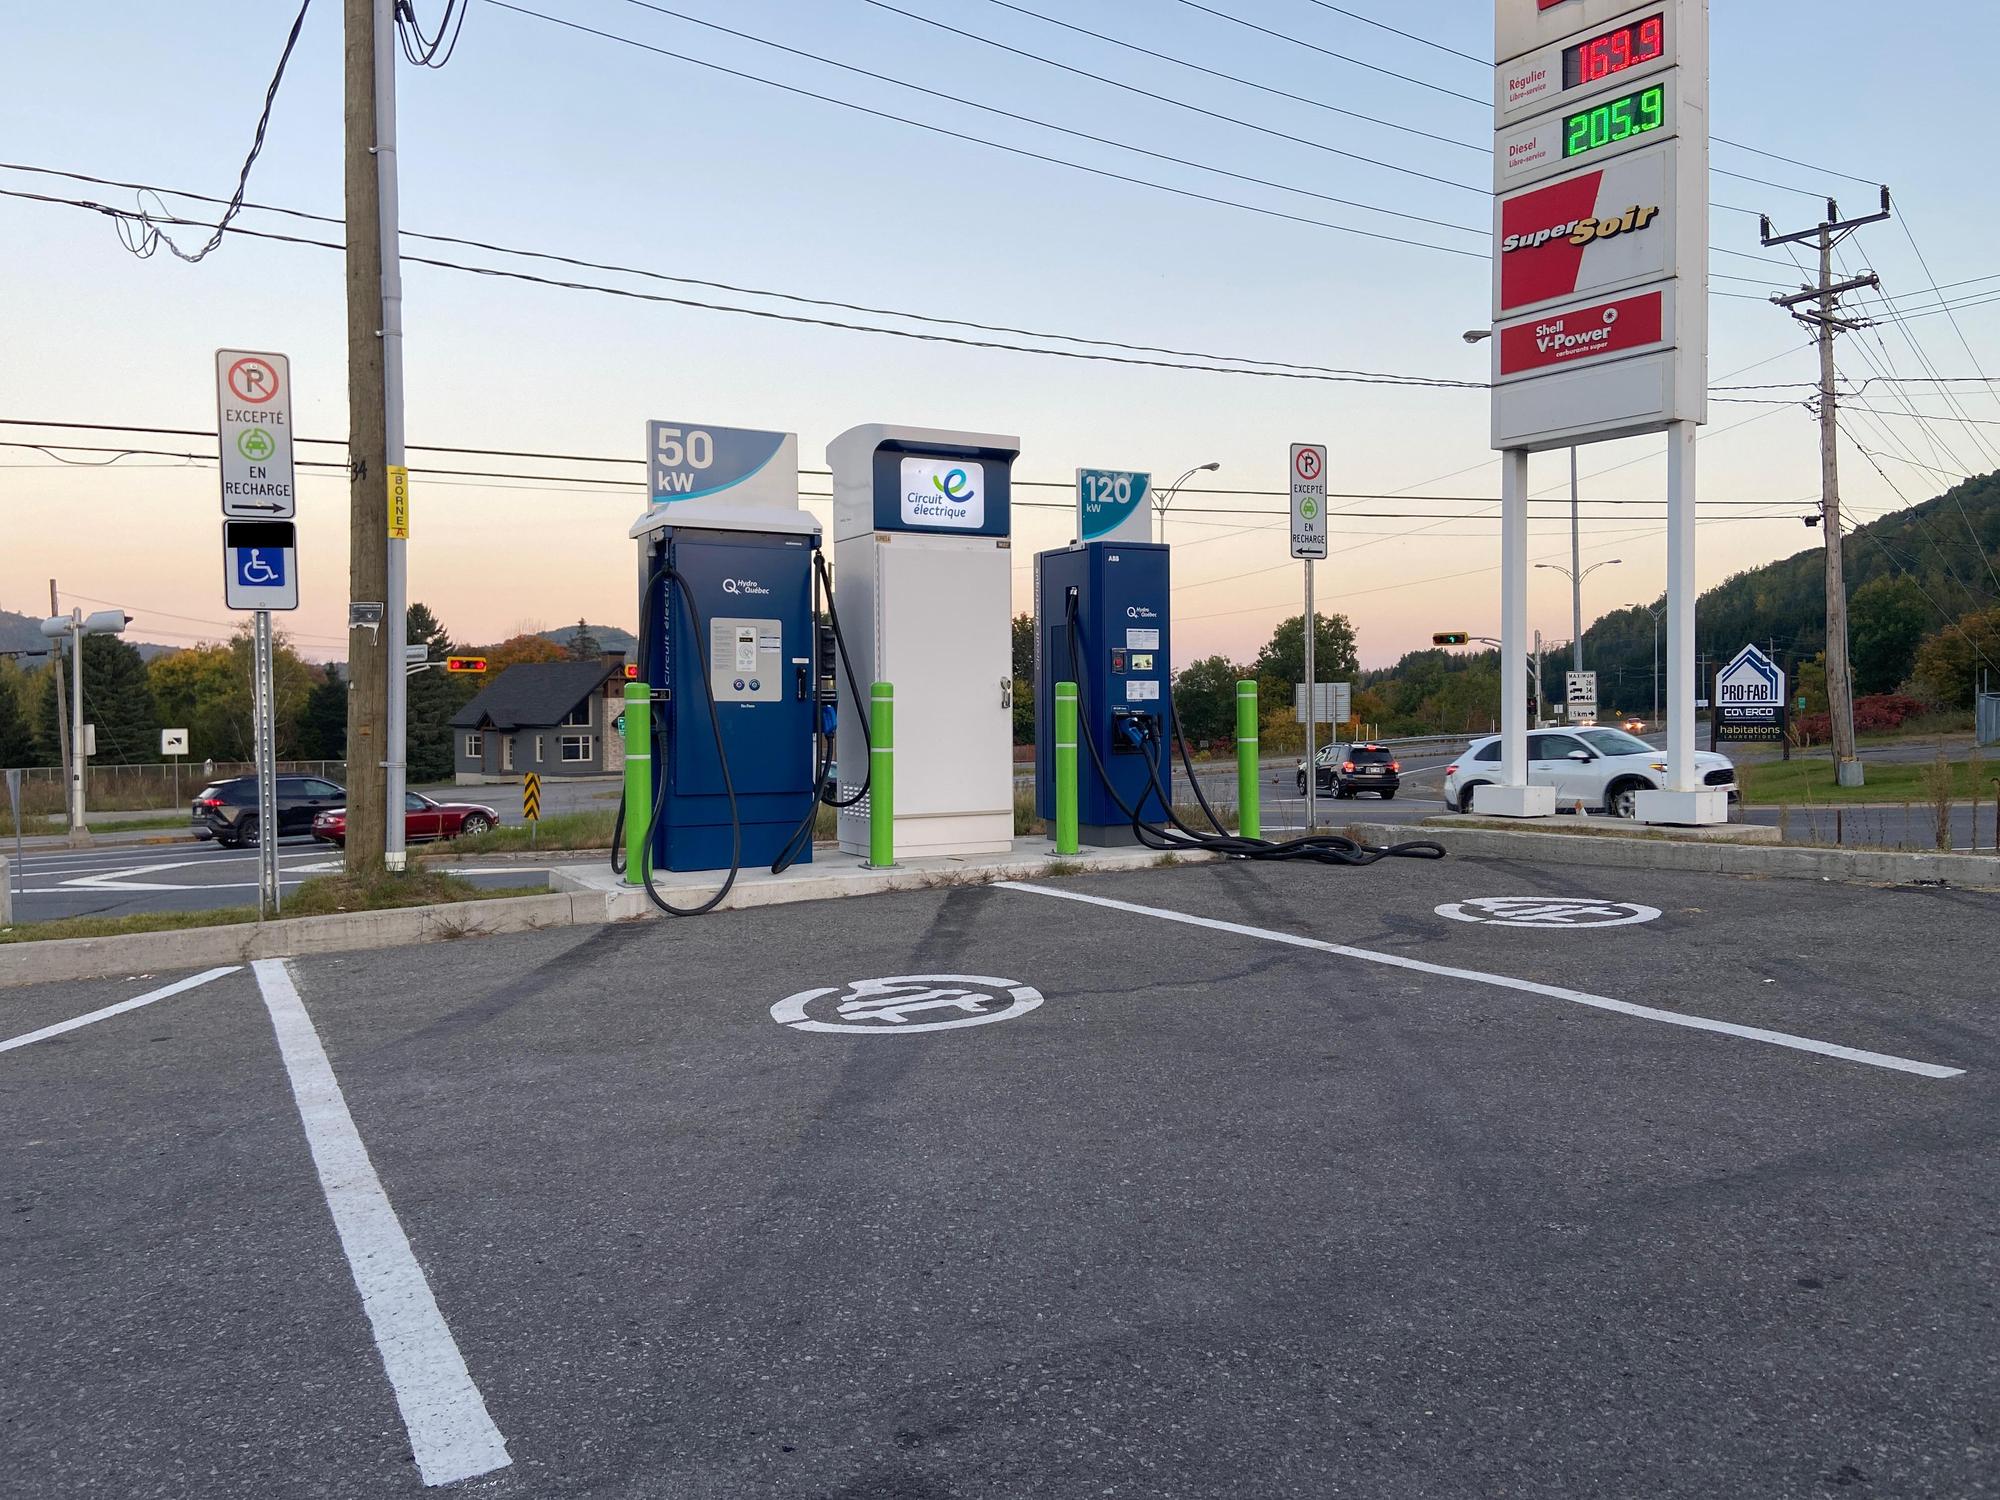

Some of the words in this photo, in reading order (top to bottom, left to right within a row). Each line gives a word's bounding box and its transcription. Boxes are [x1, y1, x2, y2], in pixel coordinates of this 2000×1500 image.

[1579, 17, 1662, 85] 169.9
[1509, 70, 1546, 91] Régulier
[1509, 83, 1546, 102] Libre-service
[1568, 88, 1662, 156] 205.9
[1509, 136, 1537, 157] Diesel
[1509, 150, 1546, 168] Libre-service
[1536, 320, 1564, 337] Shell
[1536, 326, 1612, 353] V-Power
[1556, 345, 1589, 358] carburants
[1590, 341, 1608, 350] super
[226, 408, 285, 425] EXCEPTÉ
[658, 427, 714, 469] 50
[249, 466, 267, 480] EN
[658, 470, 694, 492] kW
[225, 481, 291, 498] RECHARGE
[1086, 475, 1132, 504] 120
[394, 475, 405, 526] BORNE
[907, 492, 943, 505] Circuit
[913, 503, 967, 519] électrique
[1086, 503, 1102, 513] kW
[1304, 522, 1314, 532] EN
[1292, 534, 1325, 544] RECHARGE
[745, 586, 769, 594] Québec
[1724, 708, 1774, 716] COVERCO
[1720, 725, 1781, 734] habitations
